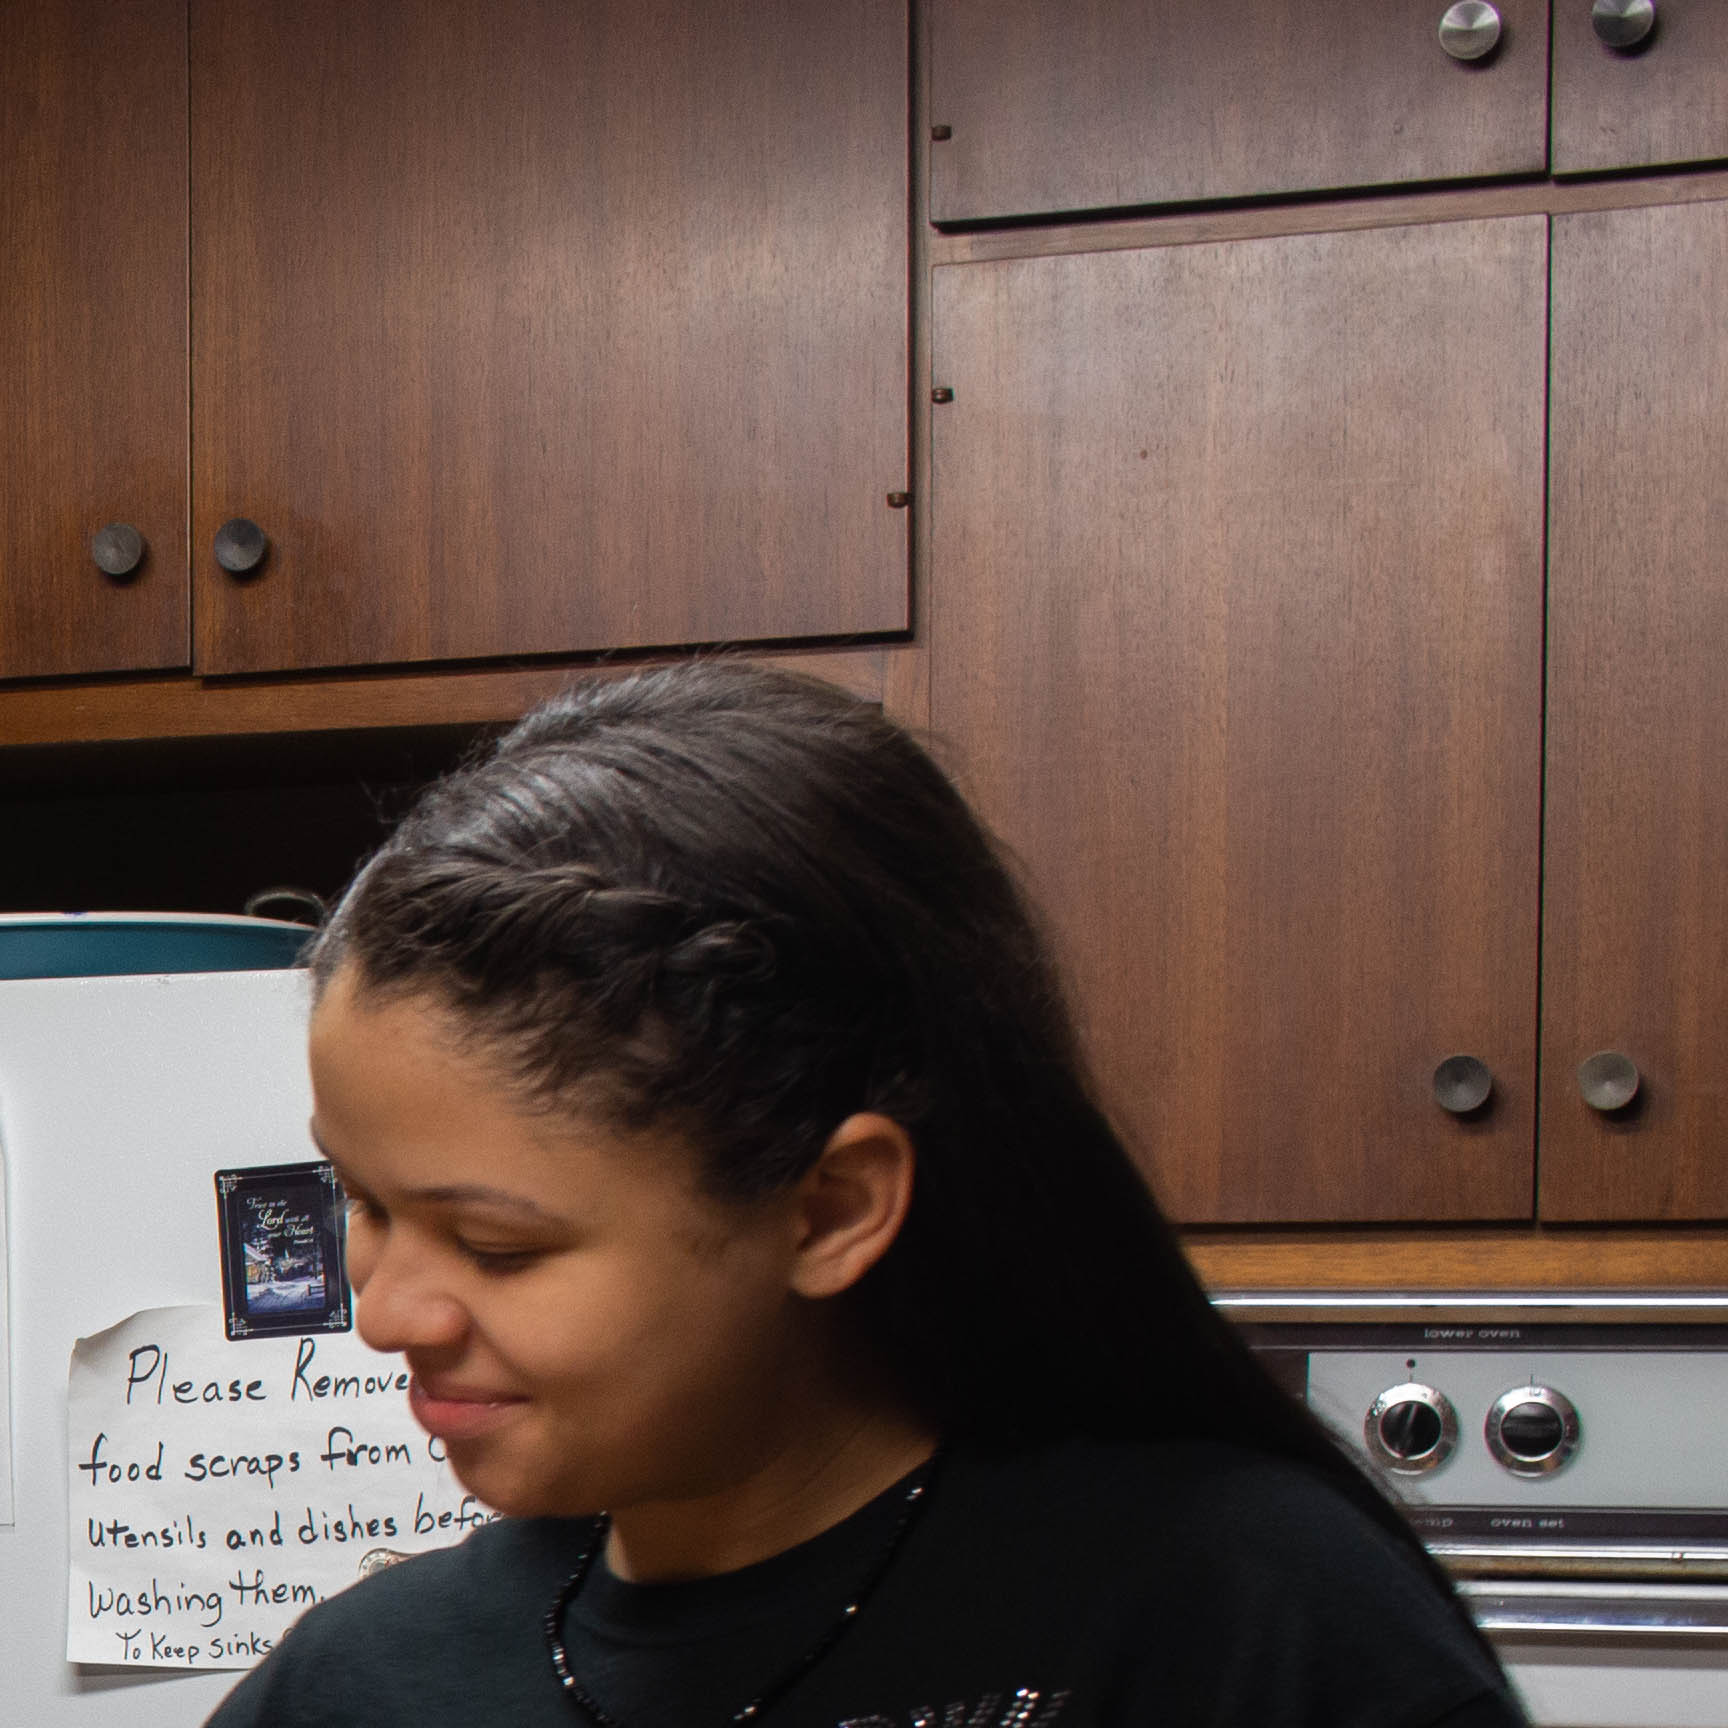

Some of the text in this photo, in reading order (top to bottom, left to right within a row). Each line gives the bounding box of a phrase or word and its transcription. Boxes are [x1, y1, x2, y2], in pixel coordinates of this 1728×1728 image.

[257, 1209, 289, 1230] Lord
[1423, 1328, 1521, 1339] lower oven
[126, 1336, 409, 1406] Please Remove
[77, 1431, 164, 1487] food
[183, 1448, 301, 1489] scraps
[319, 1426, 411, 1471] from
[225, 1509, 283, 1551] and
[297, 1503, 398, 1546] dishes
[1490, 1517, 1532, 1529] oven
[1538, 1516, 1565, 1529] set
[114, 1627, 142, 1662] To
[150, 1631, 200, 1664] Keep
